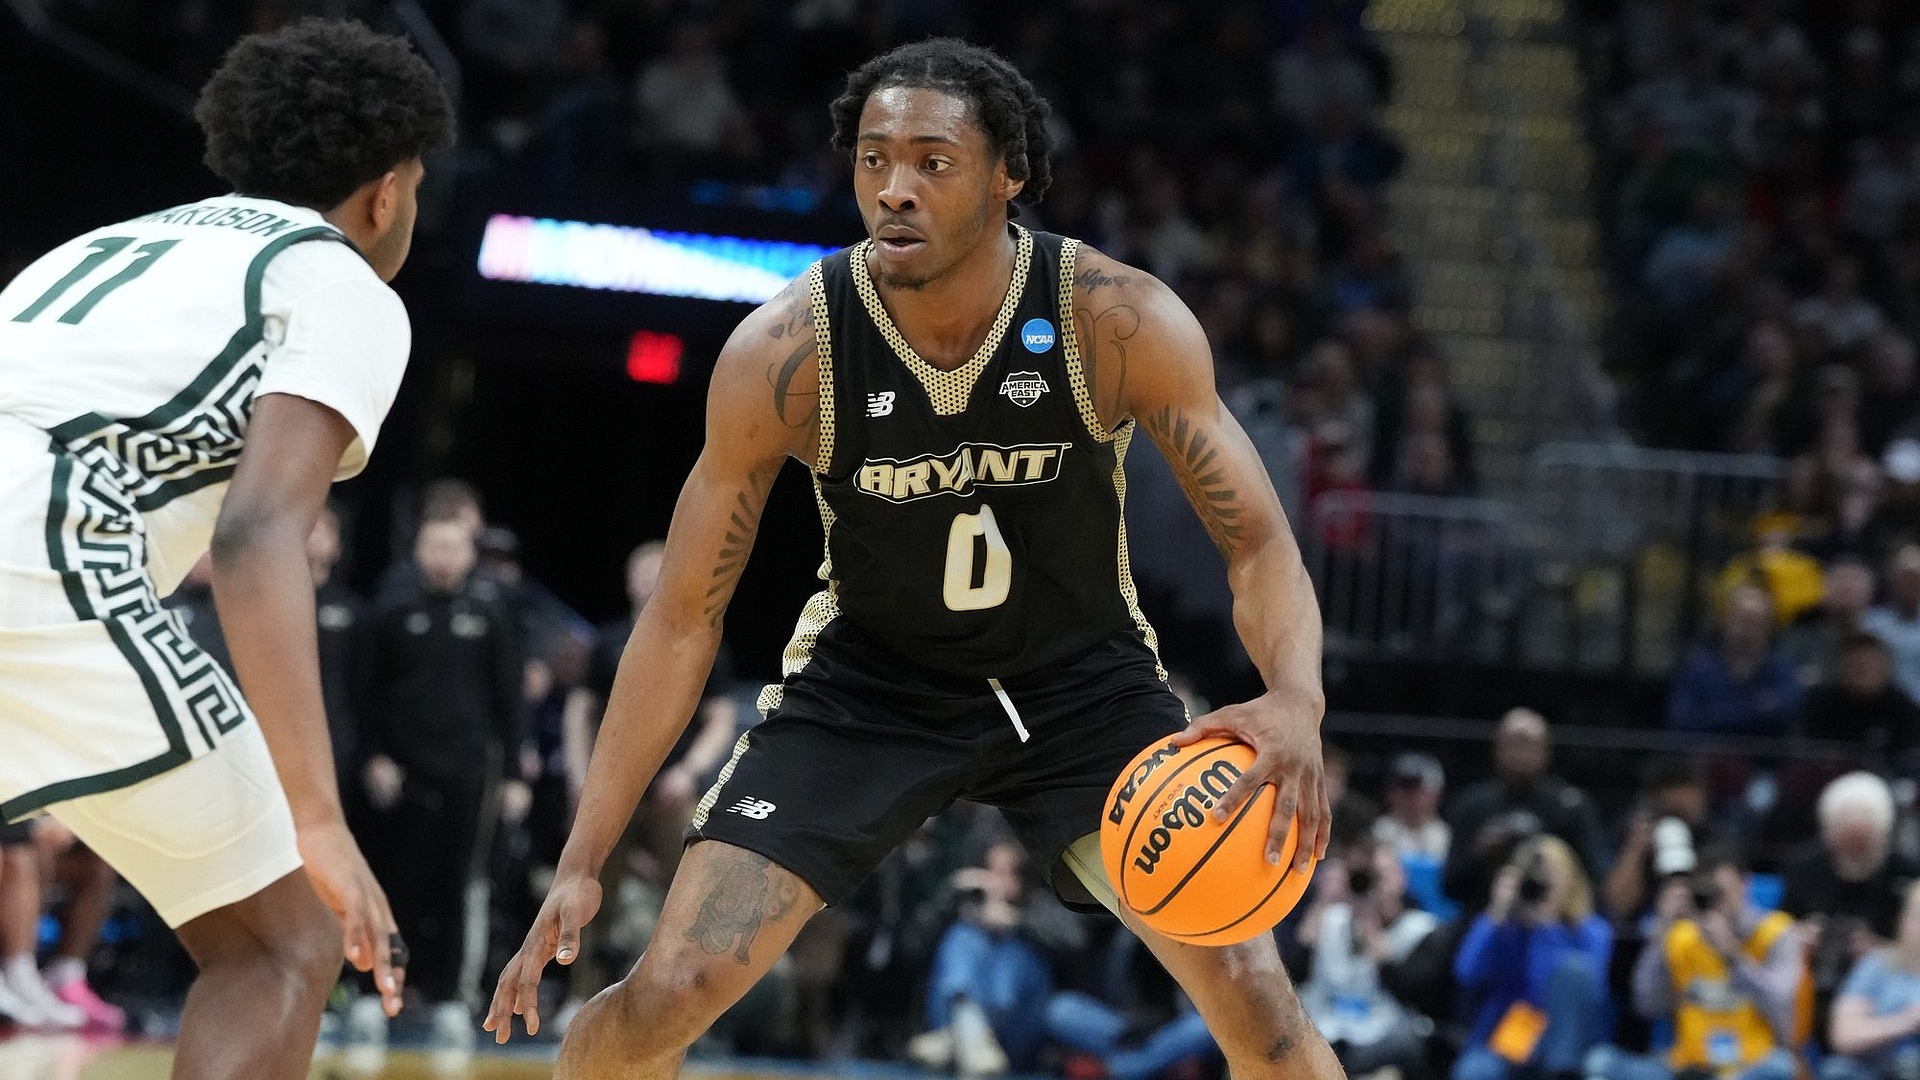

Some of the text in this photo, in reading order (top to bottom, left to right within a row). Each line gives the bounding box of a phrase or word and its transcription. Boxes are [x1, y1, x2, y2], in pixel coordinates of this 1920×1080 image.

[144, 206, 301, 237] ARDSON
[10, 236, 183, 325] 11
[1026, 334, 1054, 345] NCAA
[1002, 381, 1048, 393] AMERICA
[1011, 389, 1037, 398] EAST
[859, 447, 1057, 499] BRYANT
[943, 503, 1012, 611] 0
[1108, 741, 1181, 826] NCAA
[1134, 759, 1243, 875] Wilson
